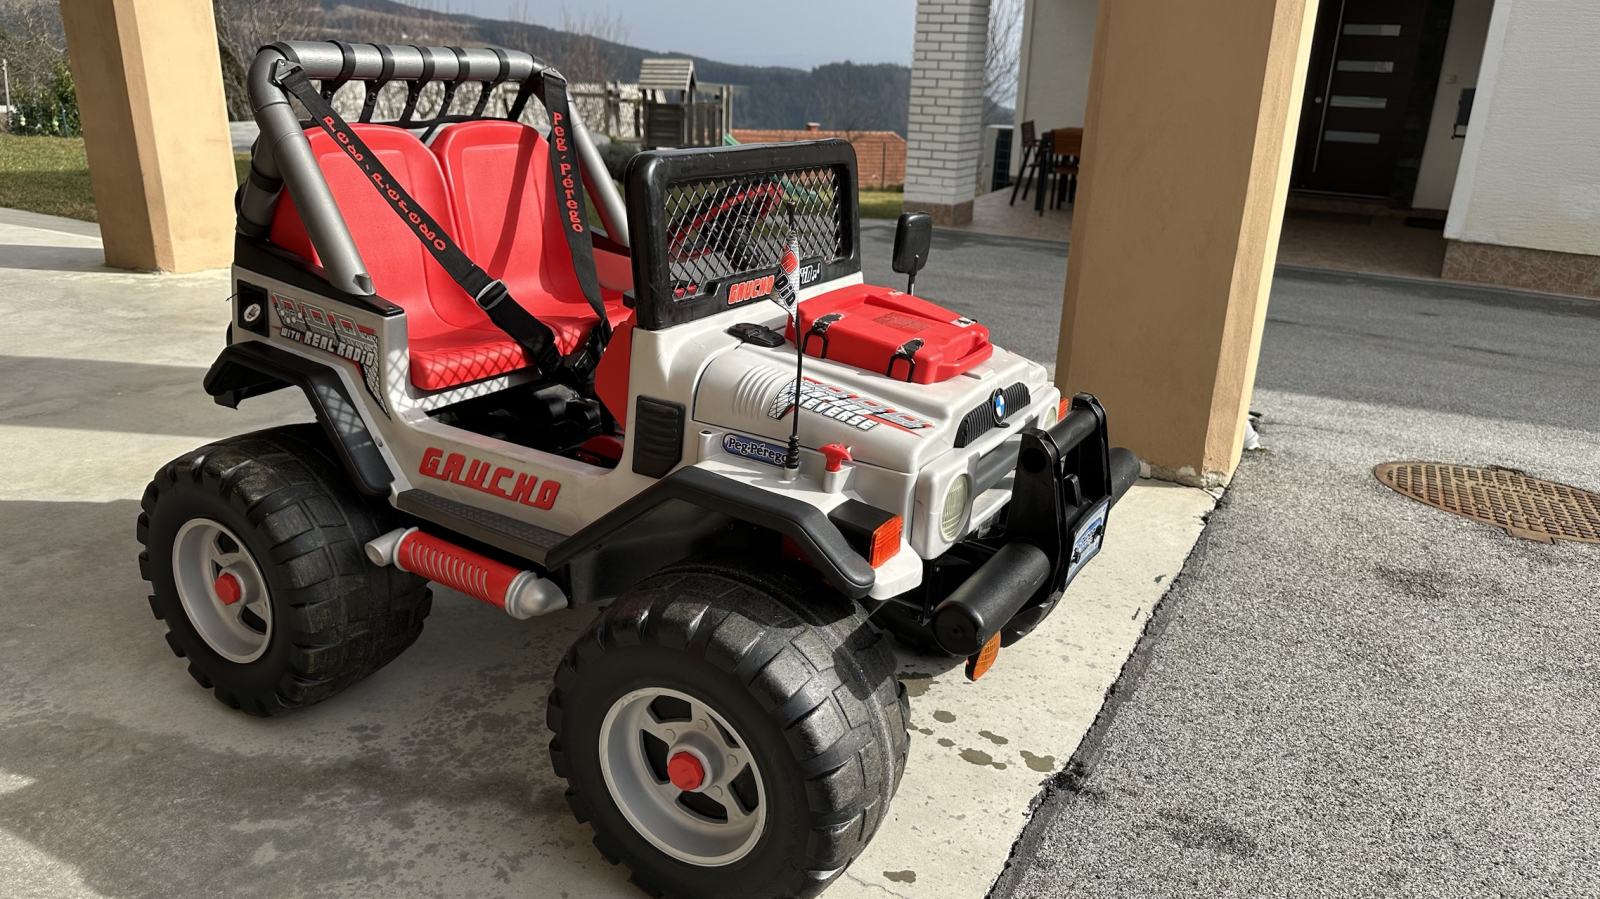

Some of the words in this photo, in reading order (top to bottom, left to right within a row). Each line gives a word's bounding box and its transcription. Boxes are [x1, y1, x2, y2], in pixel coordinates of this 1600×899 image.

[727, 274, 775, 305] GAUCHO
[304, 331, 336, 356] REAL
[419, 447, 561, 511] GAUCHO
